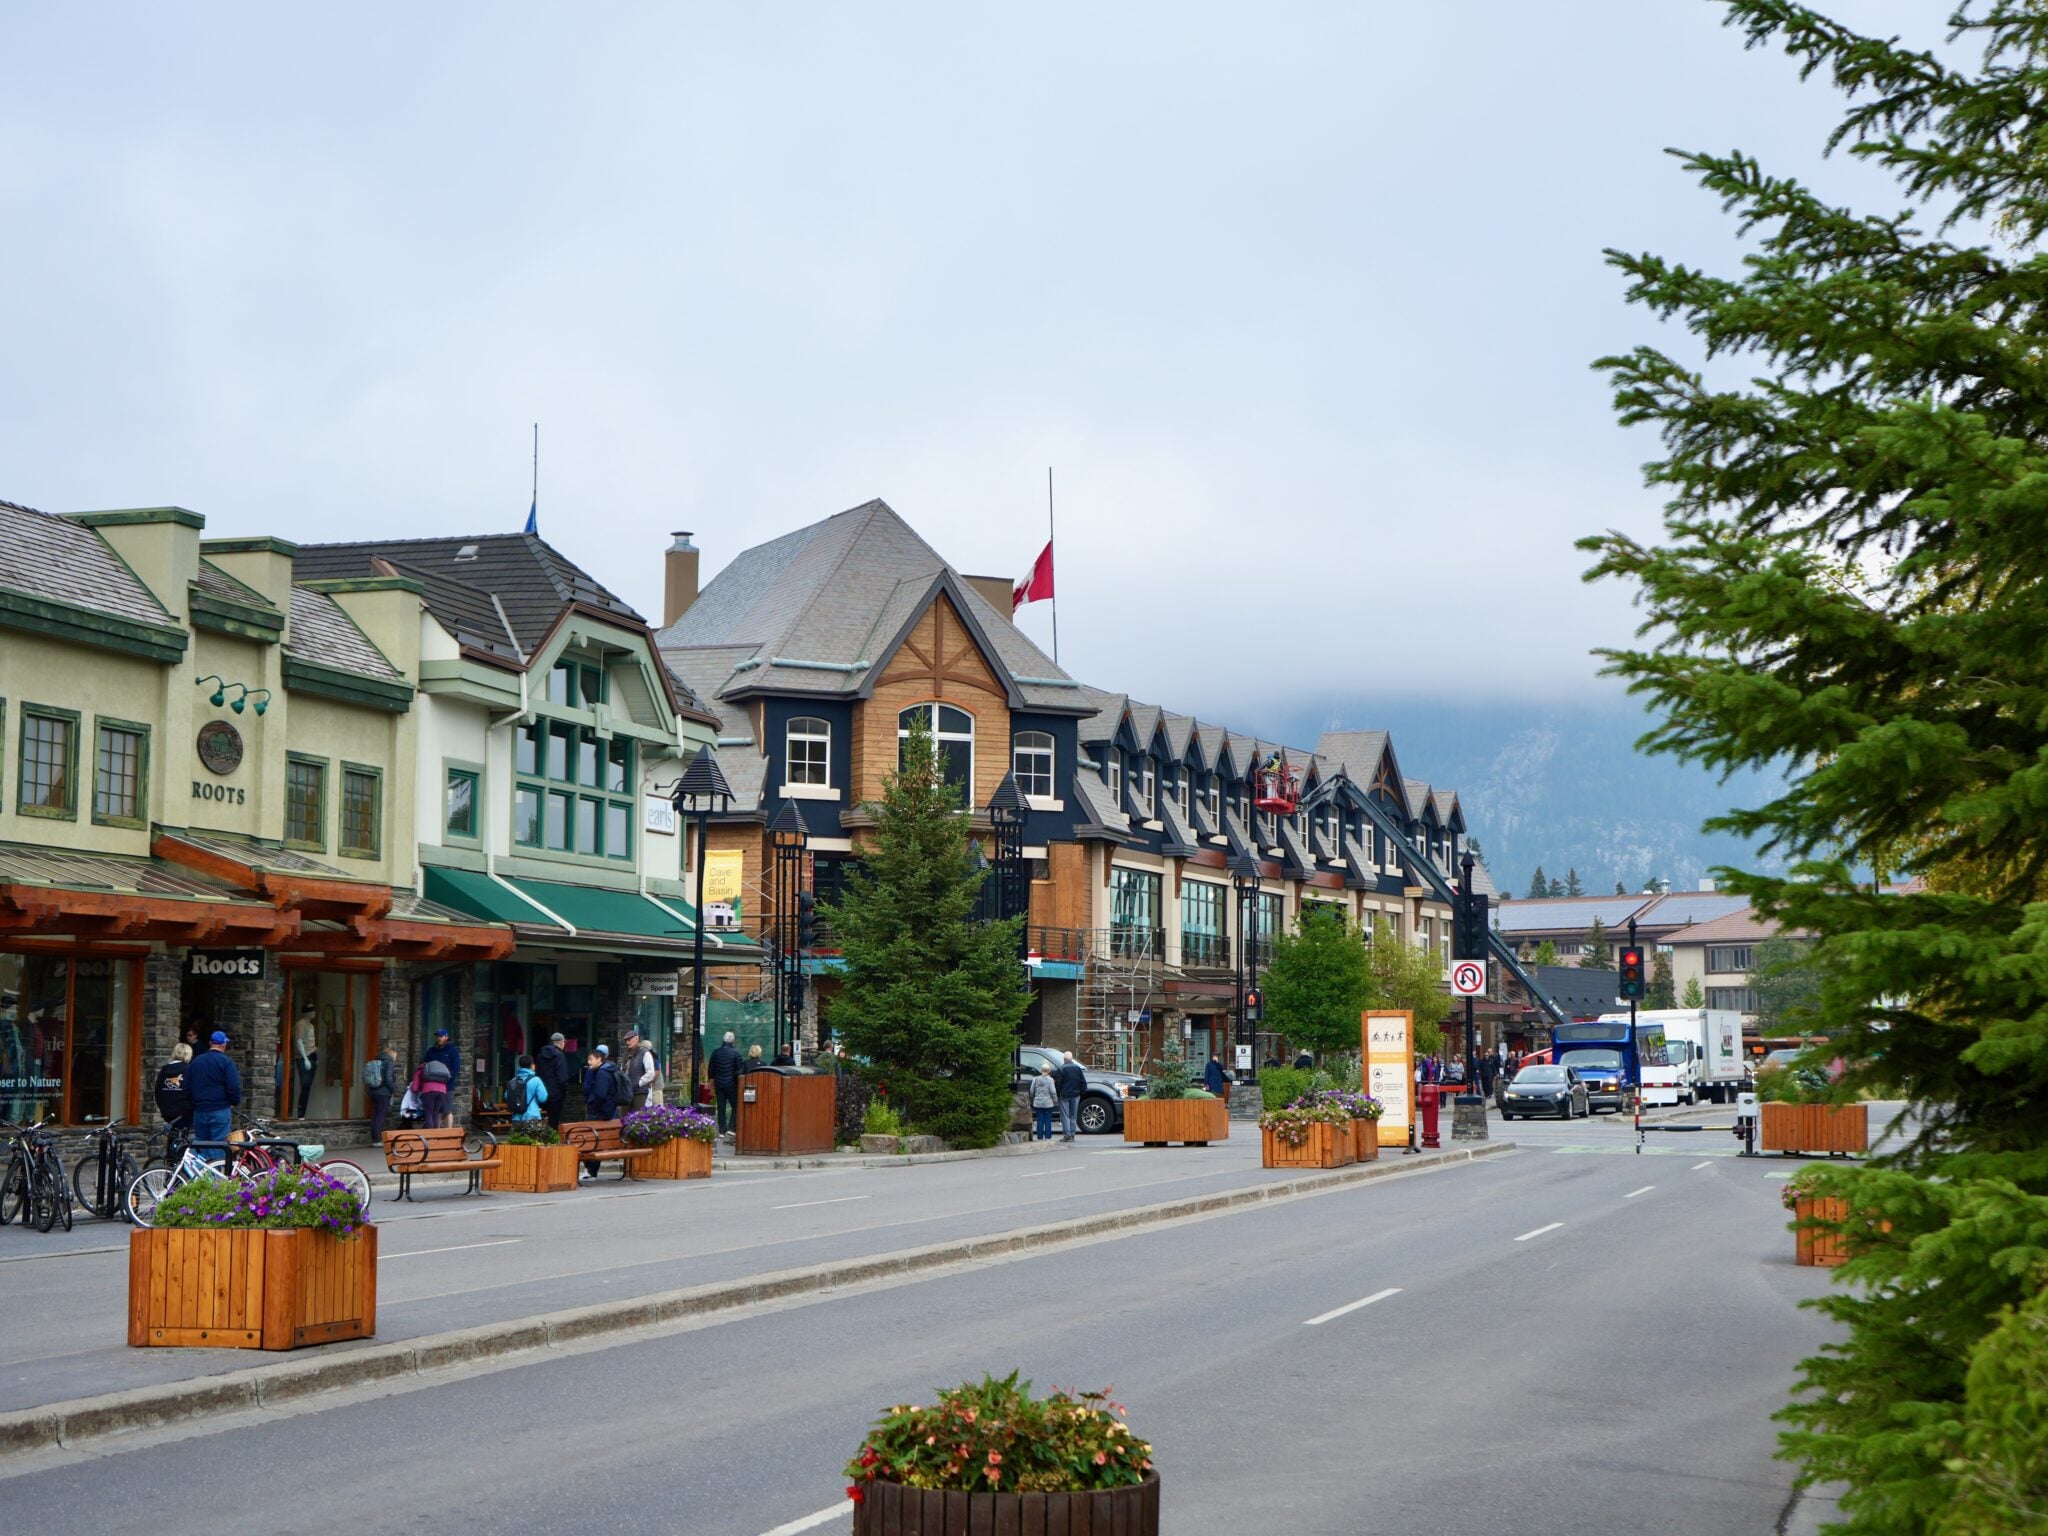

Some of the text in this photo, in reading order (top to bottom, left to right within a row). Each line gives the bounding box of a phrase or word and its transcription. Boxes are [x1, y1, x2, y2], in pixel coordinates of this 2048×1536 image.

[192, 781, 245, 805] ROOTS
[648, 803, 673, 828] earls
[709, 867, 732, 877] Cave
[709, 876, 726, 885] and
[708, 886, 733, 896] Basin
[191, 954, 259, 974] Roots
[18, 1078, 27, 1088] to
[30, 1075, 61, 1088] Nature
